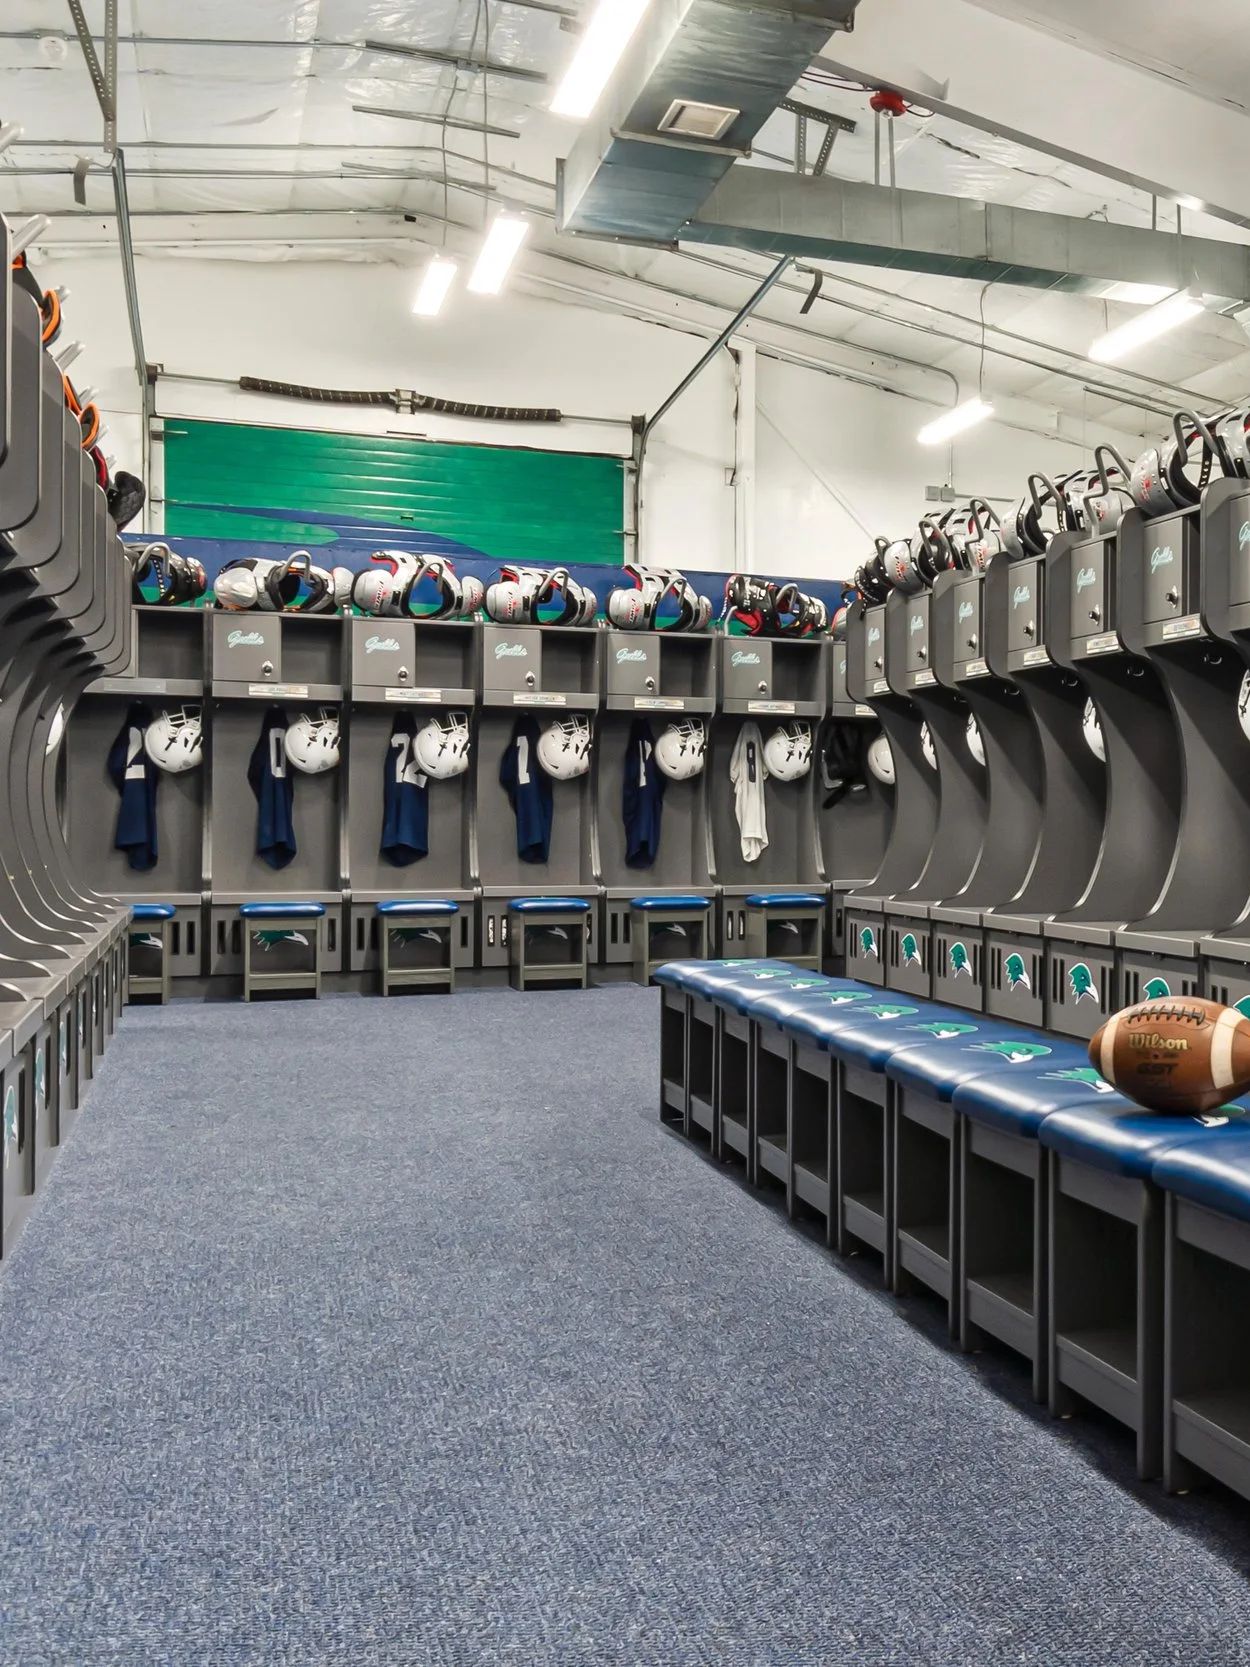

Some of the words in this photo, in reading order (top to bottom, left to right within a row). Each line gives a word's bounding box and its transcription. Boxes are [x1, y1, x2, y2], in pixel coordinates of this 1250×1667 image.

[227, 630, 265, 648] Gulls
[365, 636, 400, 653] Gulls
[494, 642, 527, 660] Gulls
[616, 647, 647, 664] Gulls
[731, 651, 761, 667] Gulls
[1128, 1032, 1189, 1051] Wilson
